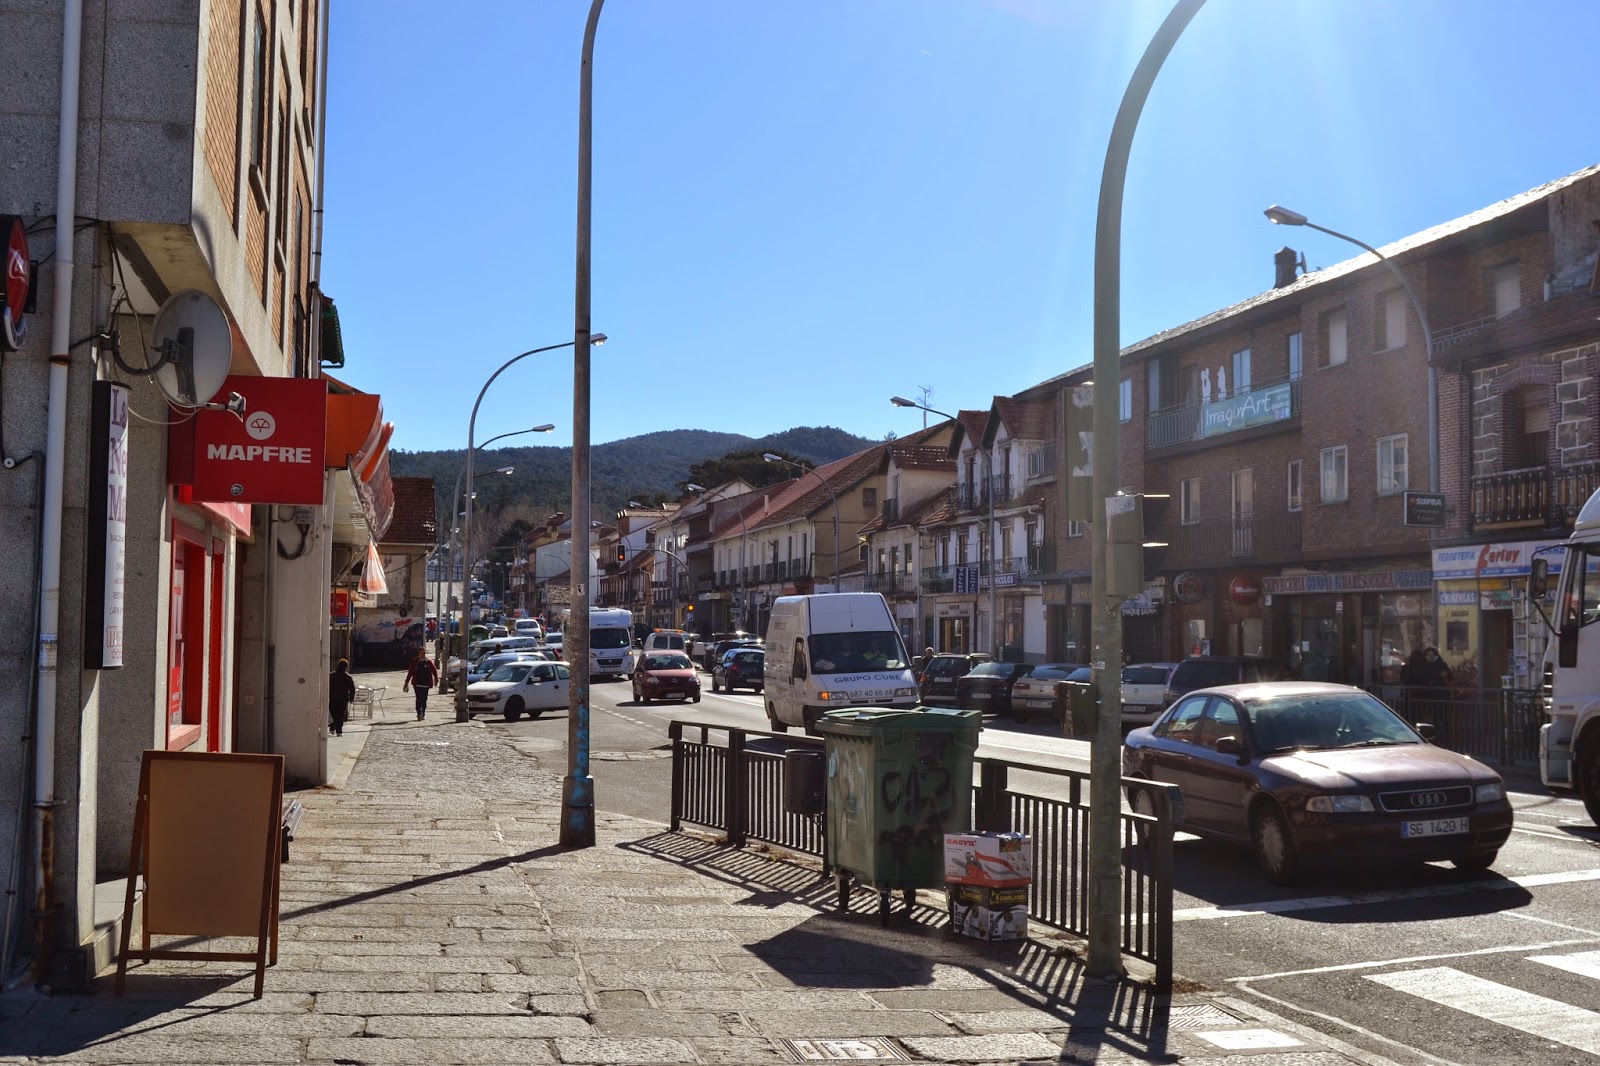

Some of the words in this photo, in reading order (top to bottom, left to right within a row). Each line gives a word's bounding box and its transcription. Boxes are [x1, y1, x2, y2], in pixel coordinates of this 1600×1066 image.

[207, 443, 312, 464] MAPFRE
[1415, 497, 1442, 506] SUPRA
[1438, 551, 1475, 562] FERRETERIA
[834, 675, 871, 683] GRUPO
[850, 690, 863, 698] 687
[874, 689, 883, 697] 65
[1409, 822, 1424, 835] SG
[999, 894, 1026, 902] GARLAND
